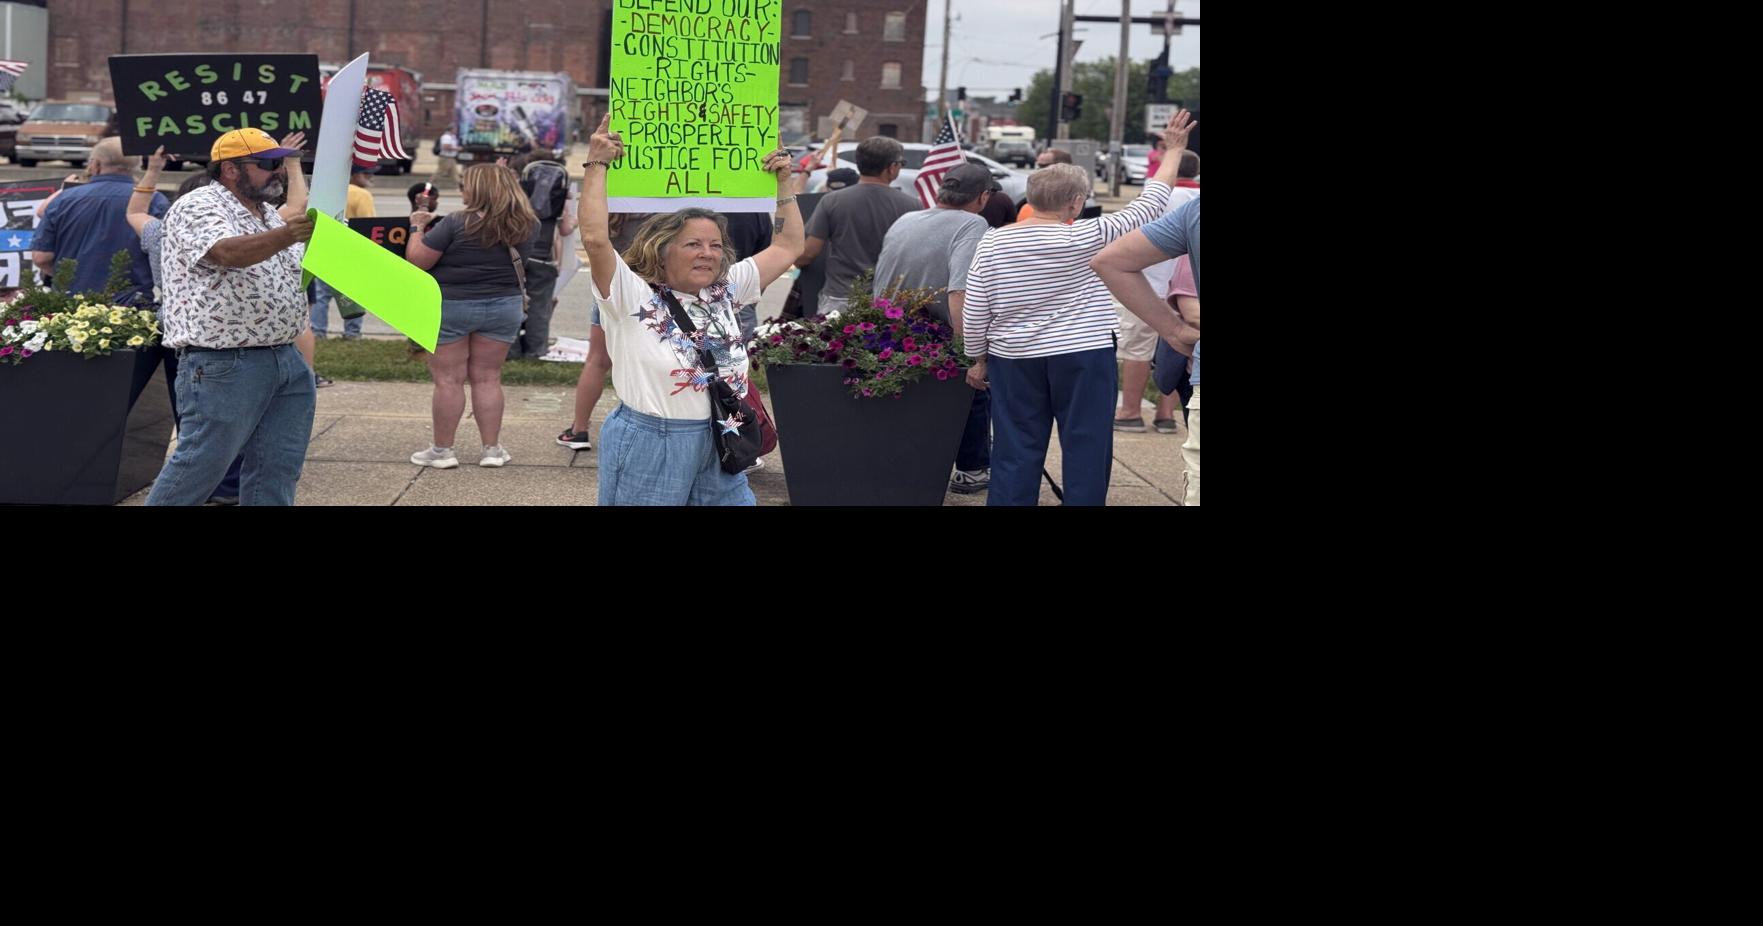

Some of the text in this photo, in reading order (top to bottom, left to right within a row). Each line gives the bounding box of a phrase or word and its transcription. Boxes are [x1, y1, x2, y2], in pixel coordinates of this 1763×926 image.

[138, 62, 309, 101] RESIST
[611, 77, 734, 104] NEIGHBOR'S
[201, 90, 267, 106] 86 47
[136, 110, 312, 137] FASCISM
[612, 144, 760, 171] JUSTICE FOR
[666, 171, 722, 194] ALL
[371, 226, 407, 245] EQ
